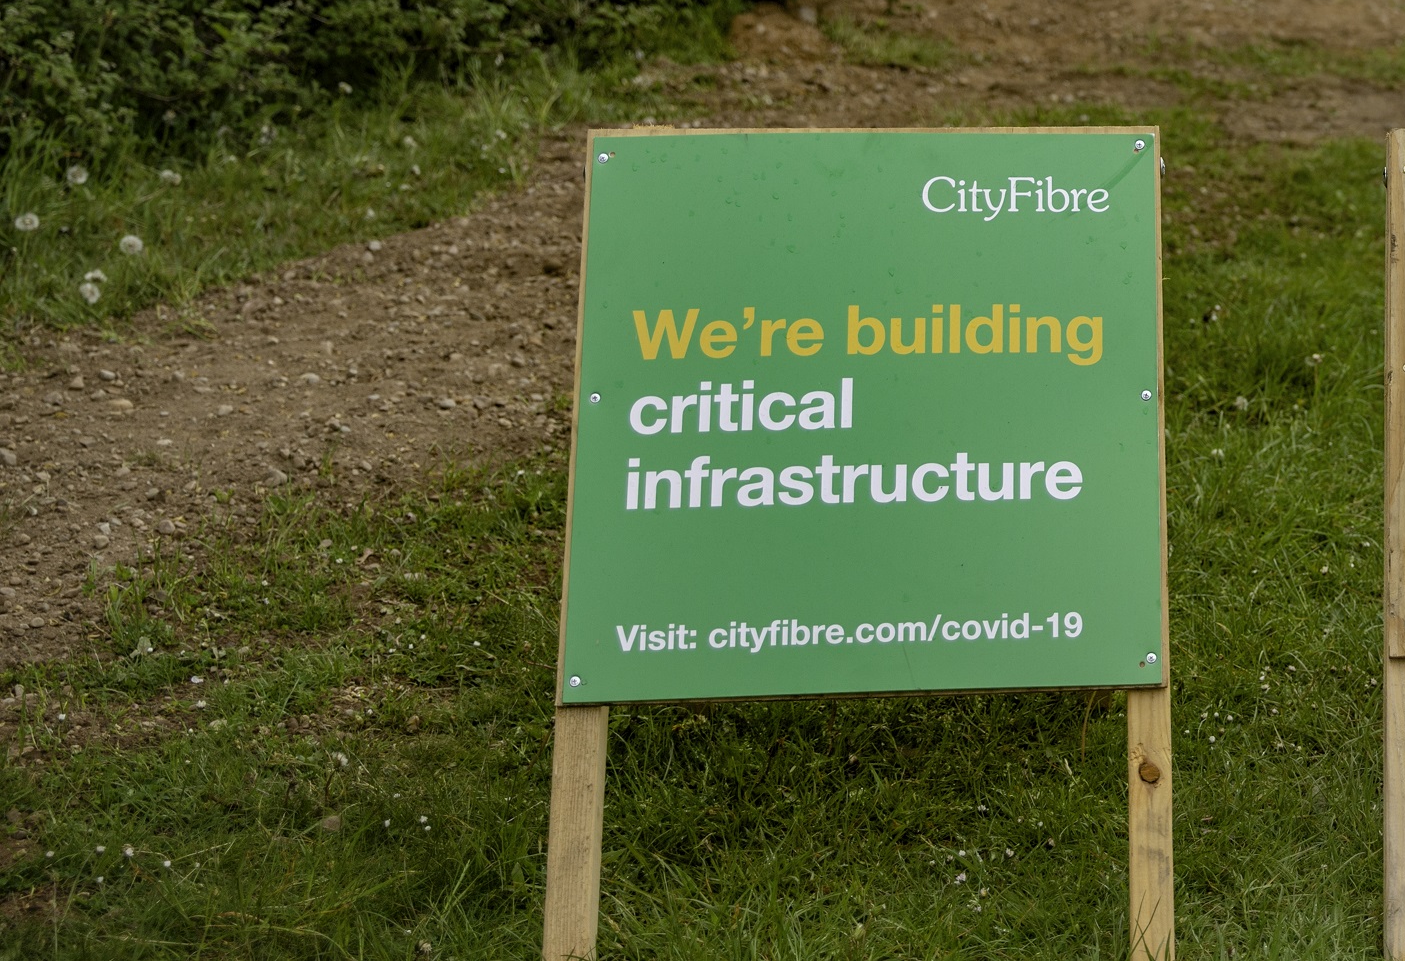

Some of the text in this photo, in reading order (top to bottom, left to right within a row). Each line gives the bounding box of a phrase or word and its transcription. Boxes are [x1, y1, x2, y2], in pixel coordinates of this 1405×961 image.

[921, 175, 1111, 221] CityFibre
[633, 304, 1104, 366] We’re building
[629, 378, 854, 435] critical
[625, 452, 1083, 510] infrastructure
[616, 612, 1084, 654] Visit: cityfibre.com/covid-19
